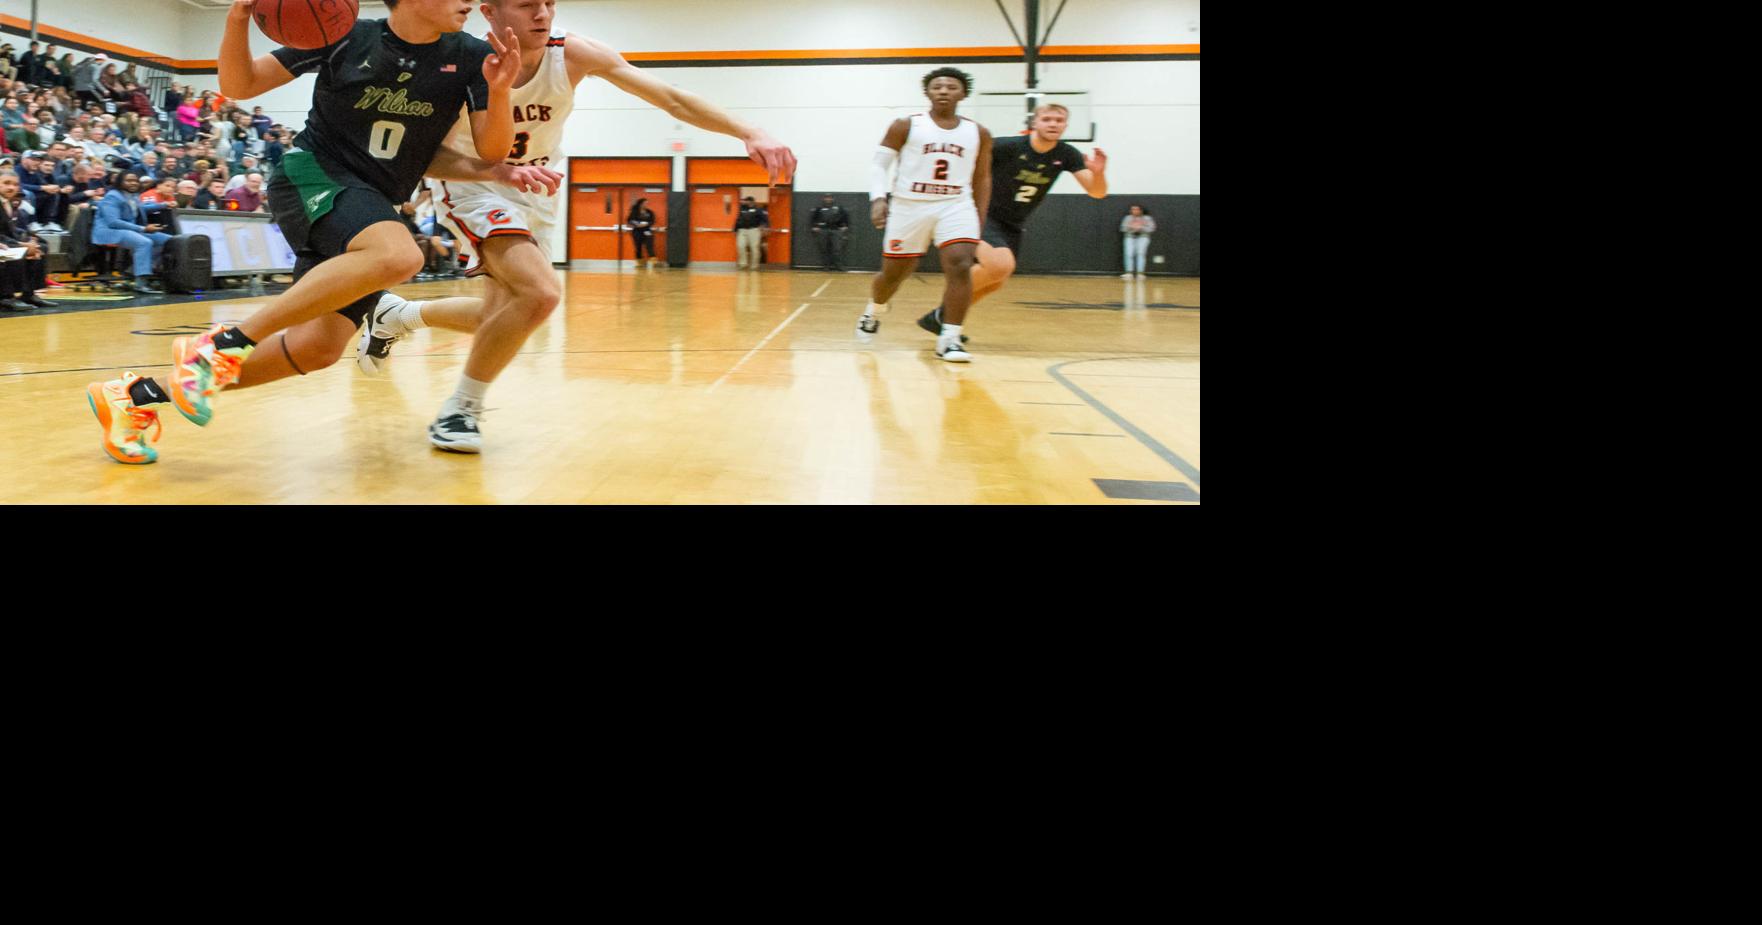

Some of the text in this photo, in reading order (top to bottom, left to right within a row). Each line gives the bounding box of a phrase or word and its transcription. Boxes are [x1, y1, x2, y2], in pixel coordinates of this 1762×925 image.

[353, 85, 434, 117] Wilson
[513, 104, 552, 123] ACK
[368, 120, 405, 160] 0
[933, 158, 950, 181] 2
[1014, 185, 1038, 203] 2
